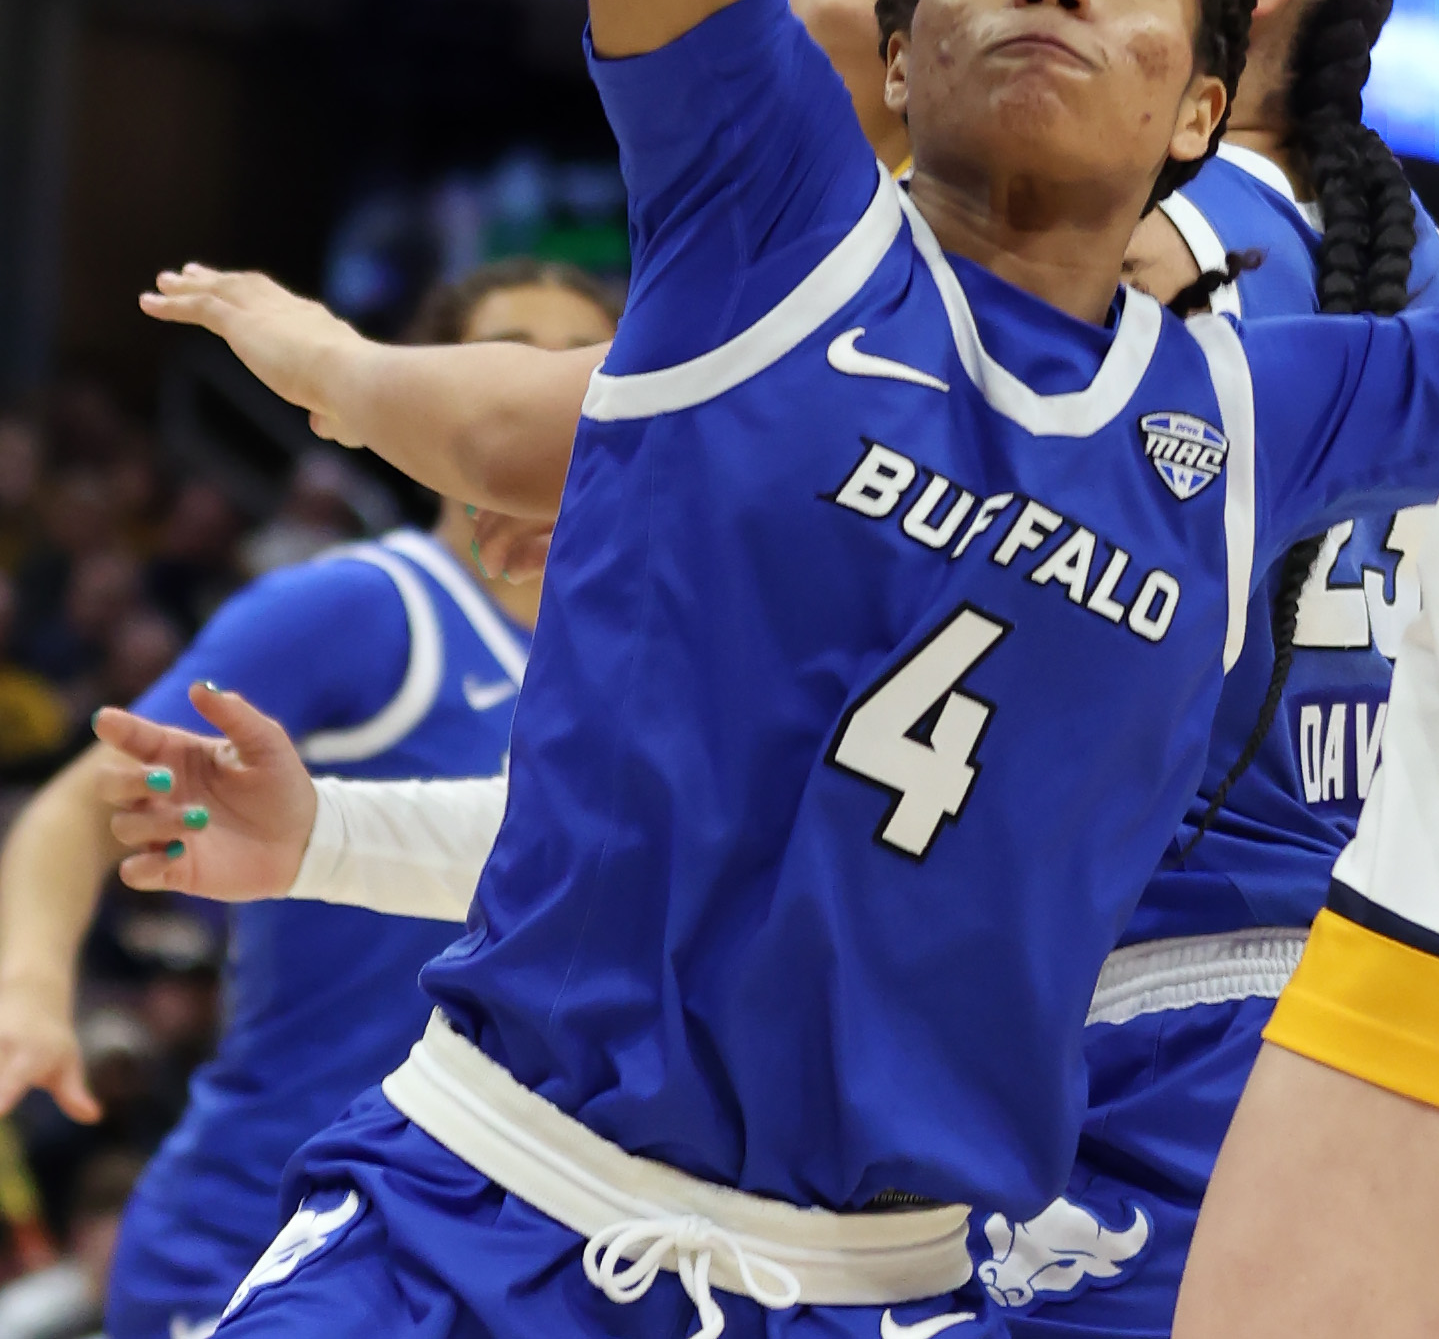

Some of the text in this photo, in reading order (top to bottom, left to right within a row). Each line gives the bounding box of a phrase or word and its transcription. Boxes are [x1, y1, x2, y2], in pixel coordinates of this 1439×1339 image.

[826, 438, 1183, 645] BUFFALO
[1145, 432, 1224, 475] MAC
[826, 602, 1012, 863] 4
